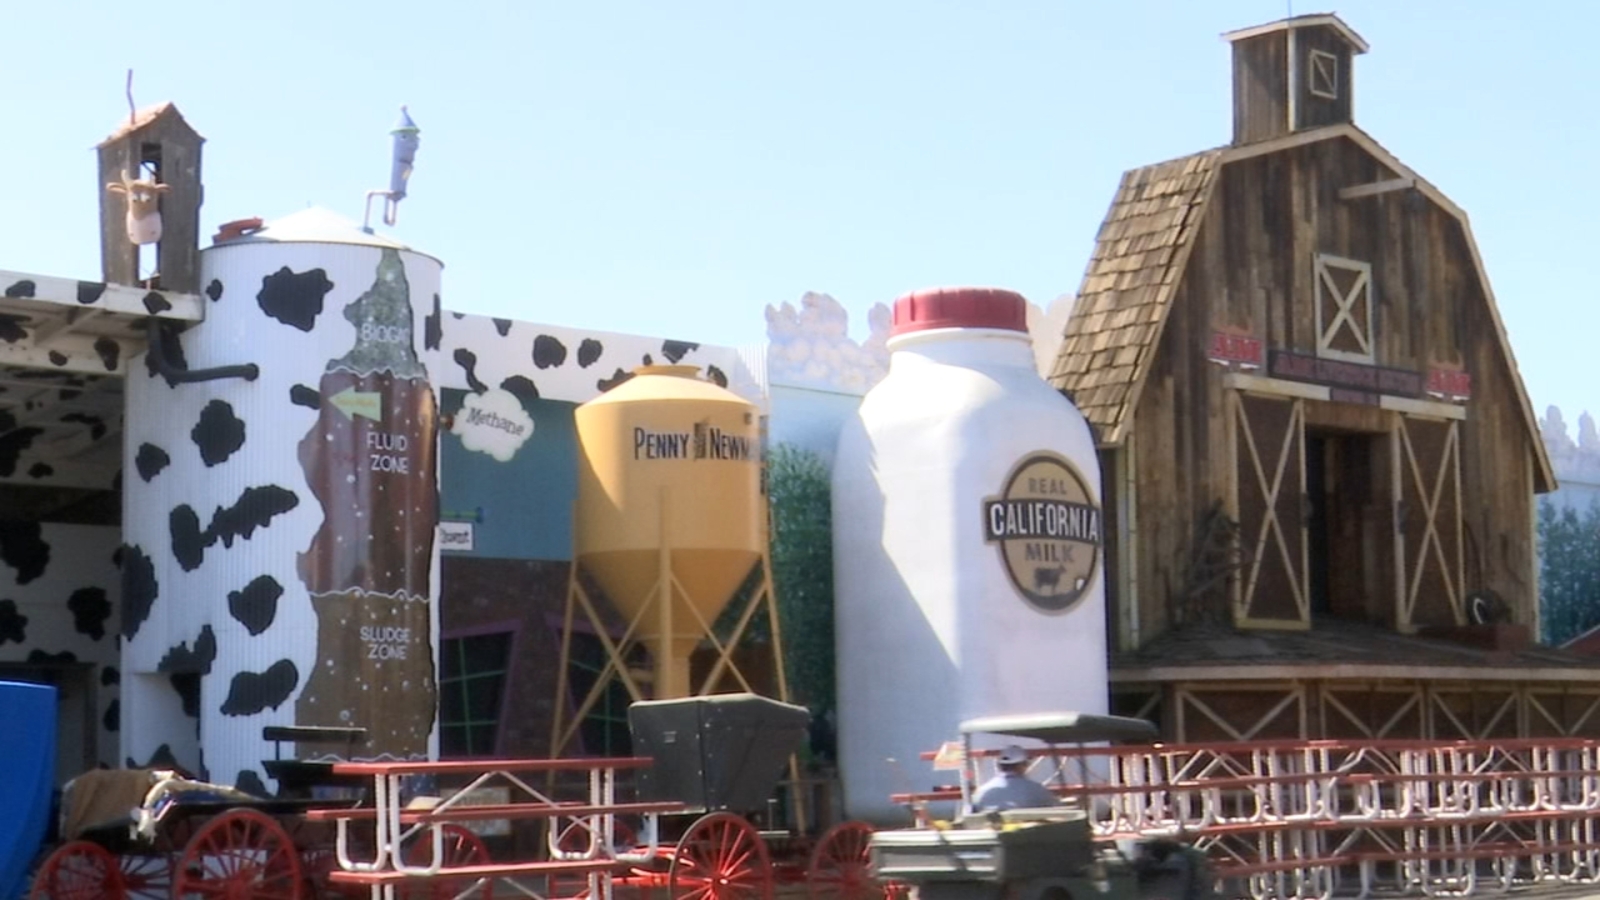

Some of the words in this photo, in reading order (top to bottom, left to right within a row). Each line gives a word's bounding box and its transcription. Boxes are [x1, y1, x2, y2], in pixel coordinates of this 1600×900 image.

[466, 407, 525, 436] Methane
[366, 431, 408, 452] FLUID
[634, 427, 690, 460] PENNY
[370, 454, 409, 474] ZONE
[1028, 477, 1068, 495] REAL
[990, 503, 1099, 541] CALIFORNIA
[1025, 542, 1074, 563] MILK
[360, 626, 410, 643] SLUDGE
[367, 644, 408, 660] ZONE
